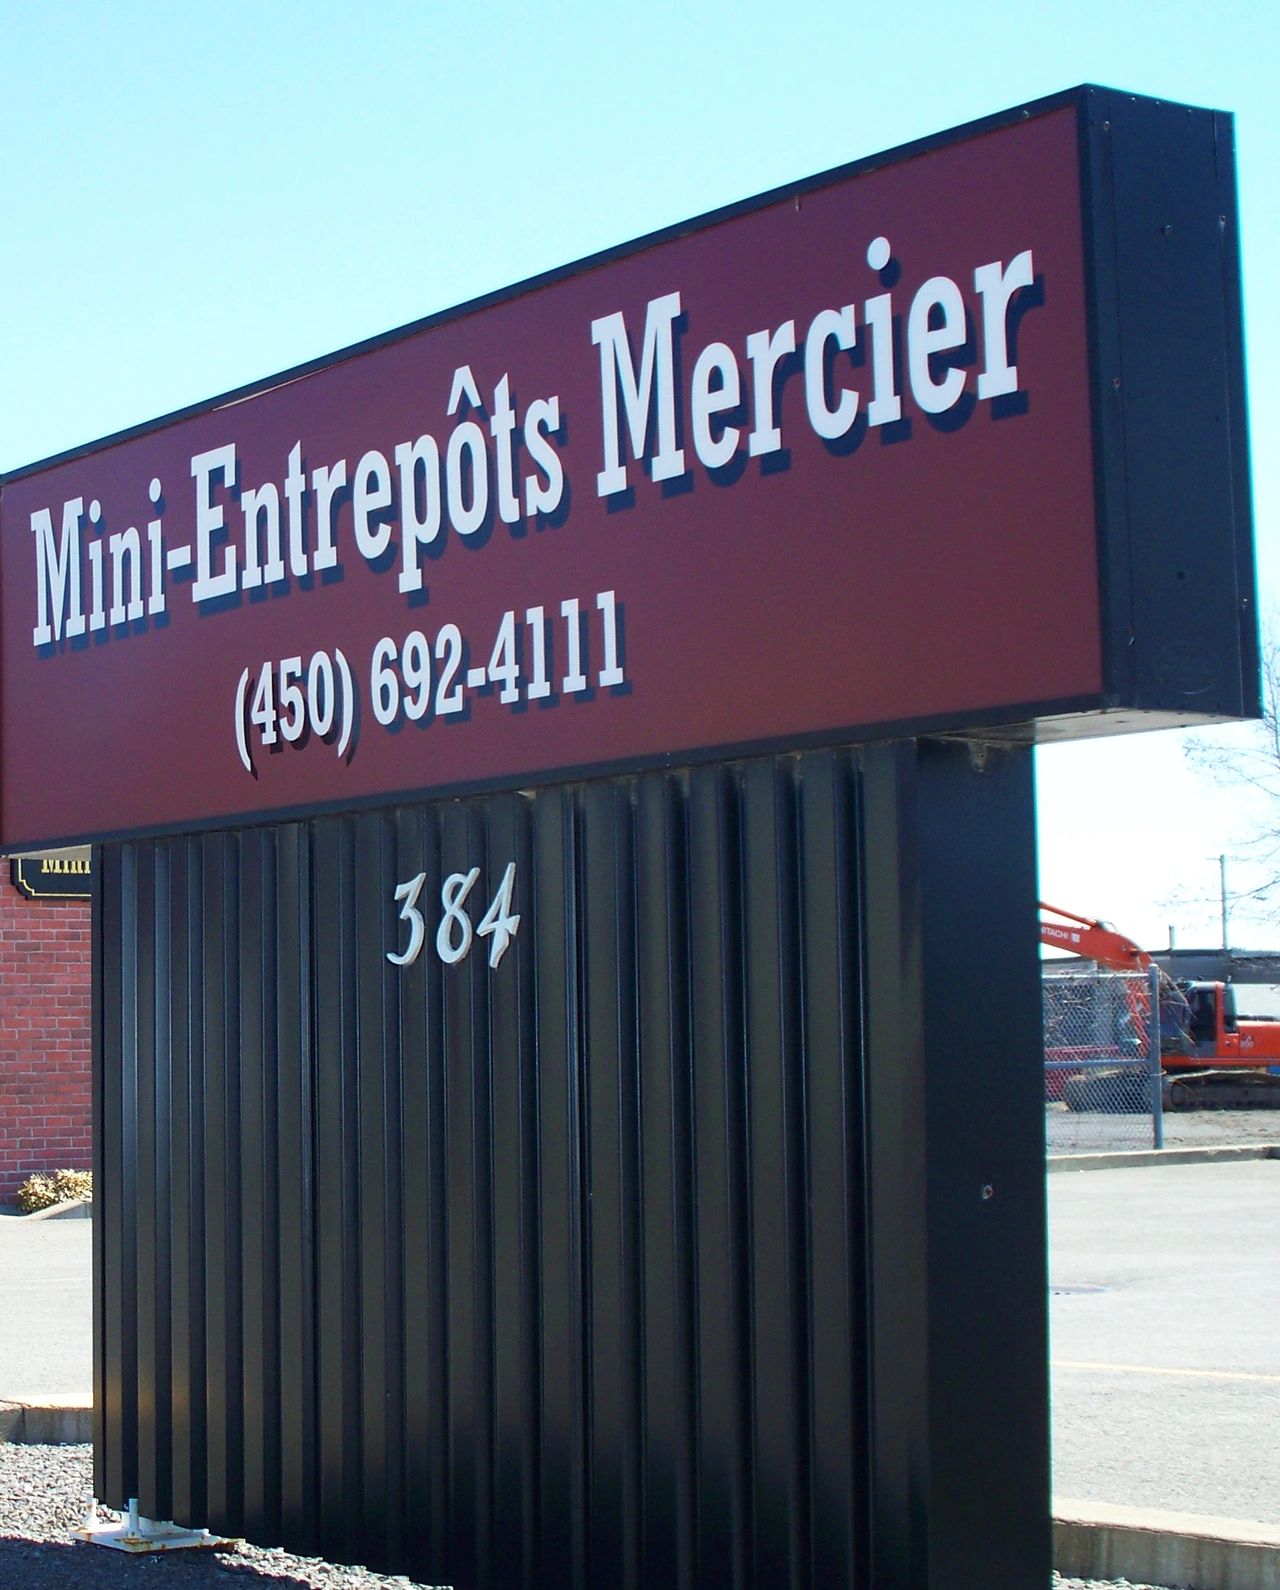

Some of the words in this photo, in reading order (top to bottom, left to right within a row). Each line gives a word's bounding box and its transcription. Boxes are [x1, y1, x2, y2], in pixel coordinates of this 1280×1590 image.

[30, 364, 564, 647] Mini-Entrepôts
[591, 236, 1034, 498] Mercier
[234, 648, 354, 772] (450)
[370, 590, 624, 725] 692-4111
[386, 861, 521, 969] 384
